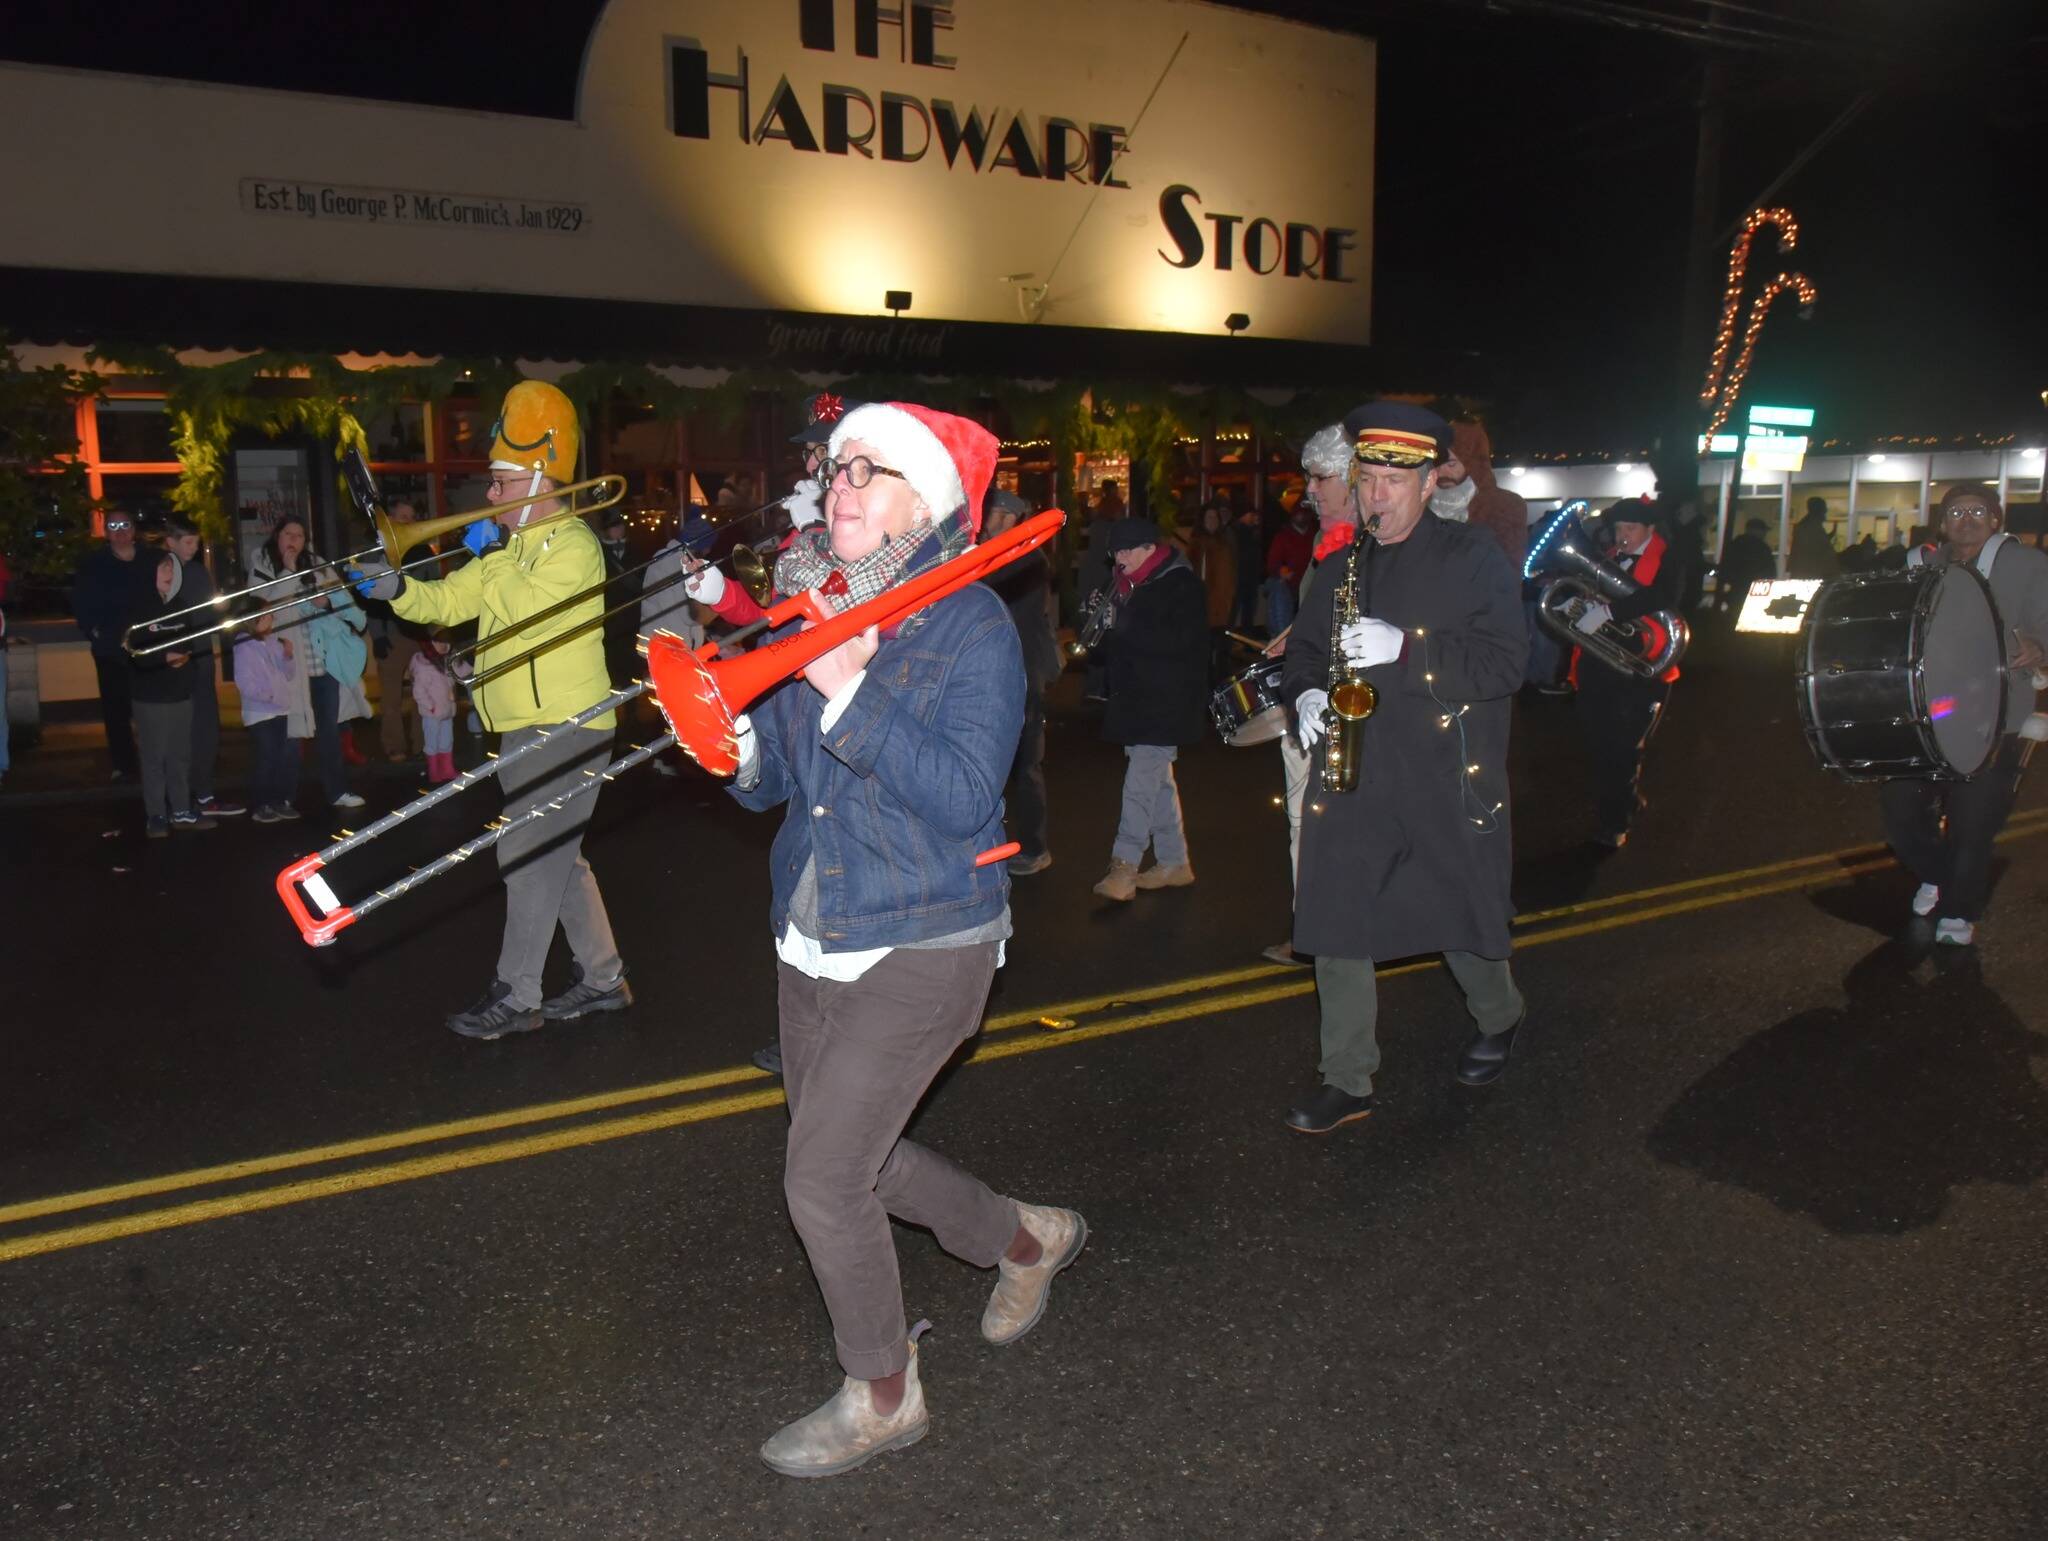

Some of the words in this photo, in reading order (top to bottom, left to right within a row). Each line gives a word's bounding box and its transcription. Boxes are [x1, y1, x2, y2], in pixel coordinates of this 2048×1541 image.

[663, 34, 1131, 189] HARDWARE
[296, 184, 316, 218] by
[321, 188, 388, 223] George
[393, 194, 408, 218] P.
[515, 204, 542, 228] Jan
[546, 207, 583, 231] 1929
[1158, 184, 1357, 283] STORE
